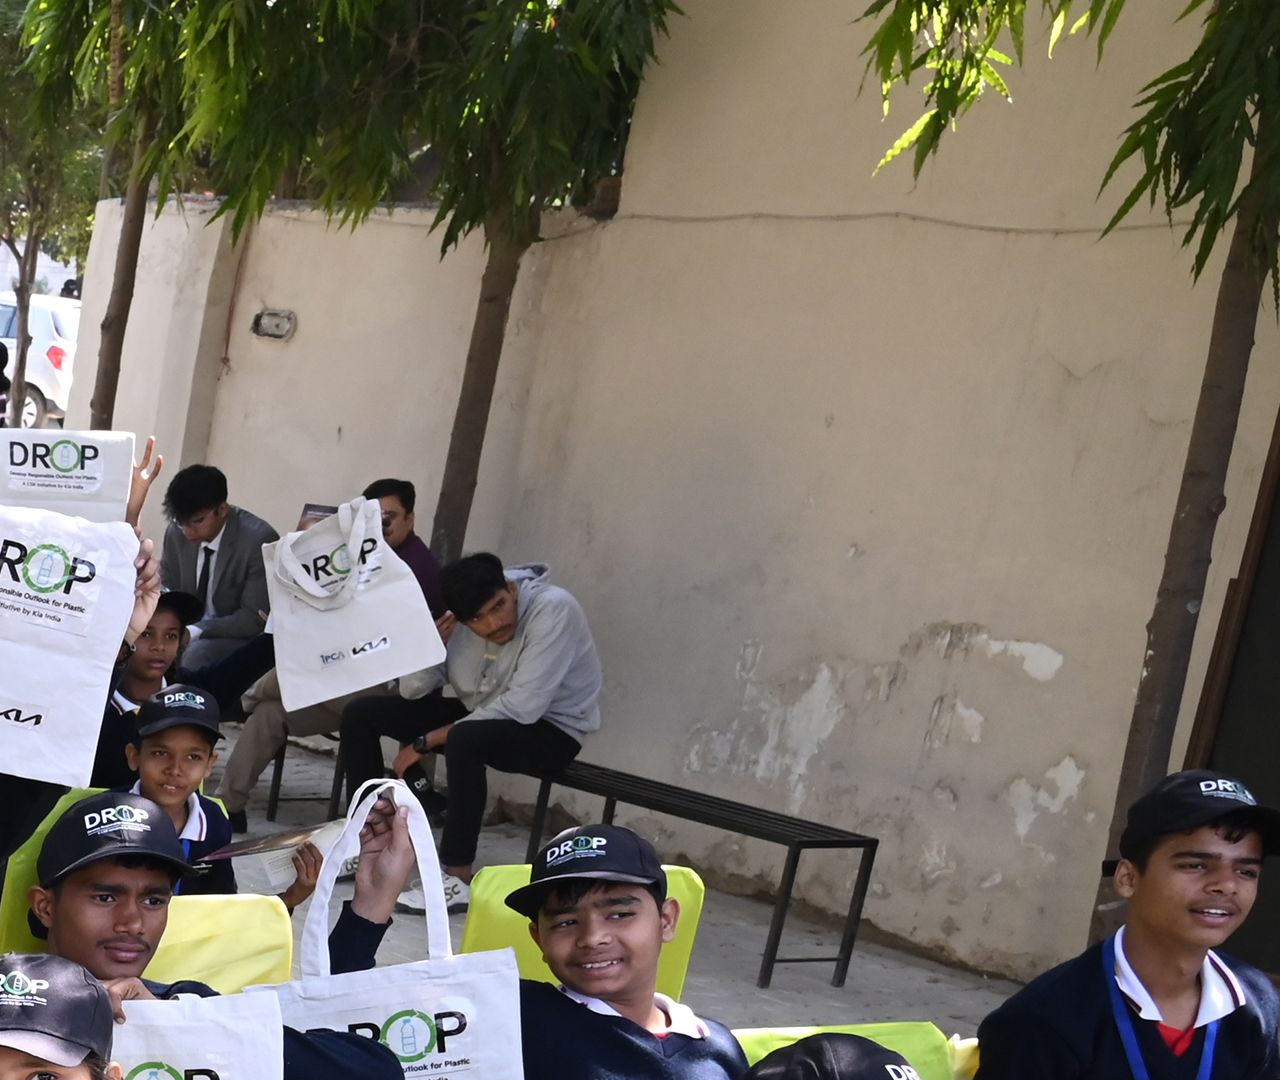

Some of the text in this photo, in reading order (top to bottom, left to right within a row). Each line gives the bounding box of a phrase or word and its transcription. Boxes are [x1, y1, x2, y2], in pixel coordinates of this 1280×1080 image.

[9, 439, 99, 473] DROP
[164, 692, 205, 704] DROP
[84, 805, 149, 829] DROP
[546, 836, 607, 862] DROP
